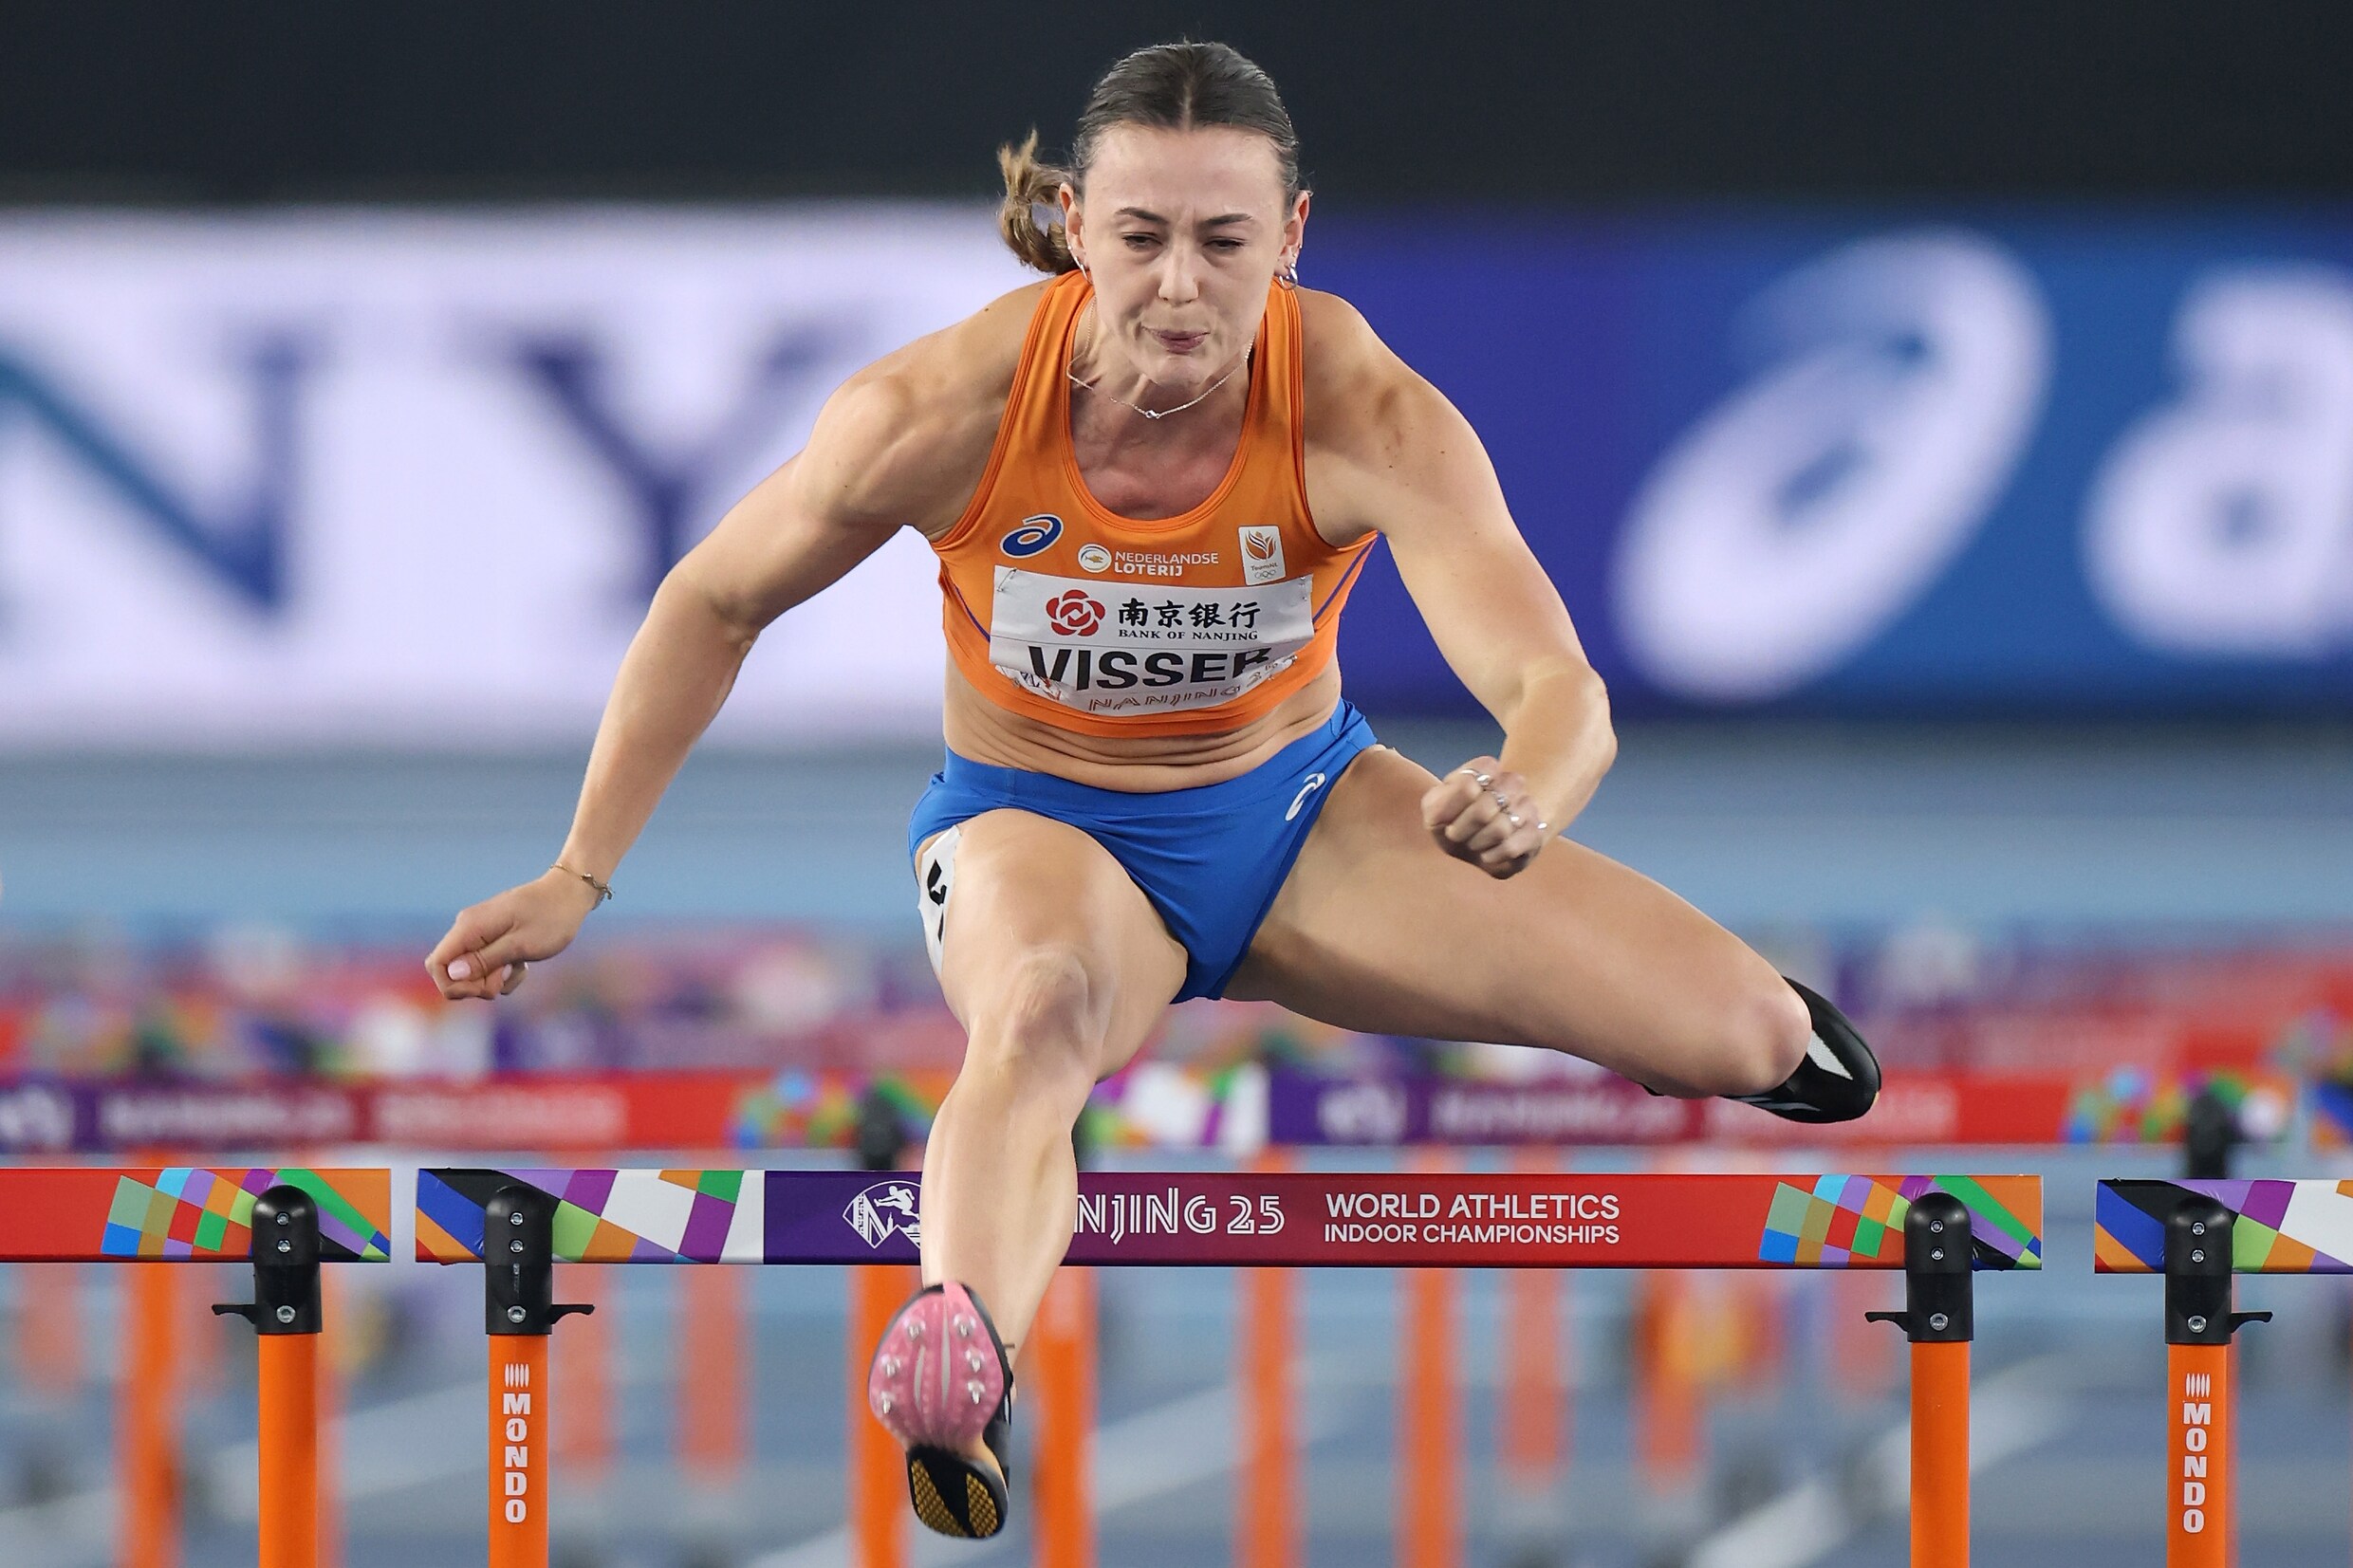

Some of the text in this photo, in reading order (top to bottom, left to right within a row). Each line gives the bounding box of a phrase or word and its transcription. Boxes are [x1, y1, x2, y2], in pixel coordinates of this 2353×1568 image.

[1114, 562, 1183, 577] LOTERIJ
[1115, 551, 1219, 564] NEDERLANDSE
[1118, 598, 1261, 629] 南京银行
[1119, 629, 1258, 641] BANK OF NANJING
[1089, 685, 1241, 711] NANJING
[1074, 1188, 1285, 1245] NJING 25
[1325, 1193, 1620, 1220] WORLD ATHLETICS
[1325, 1224, 1620, 1245] INDOOR CHAMPIONSHIPS
[503, 1393, 530, 1523] MONDO
[2183, 1403, 2211, 1533] MONDO
